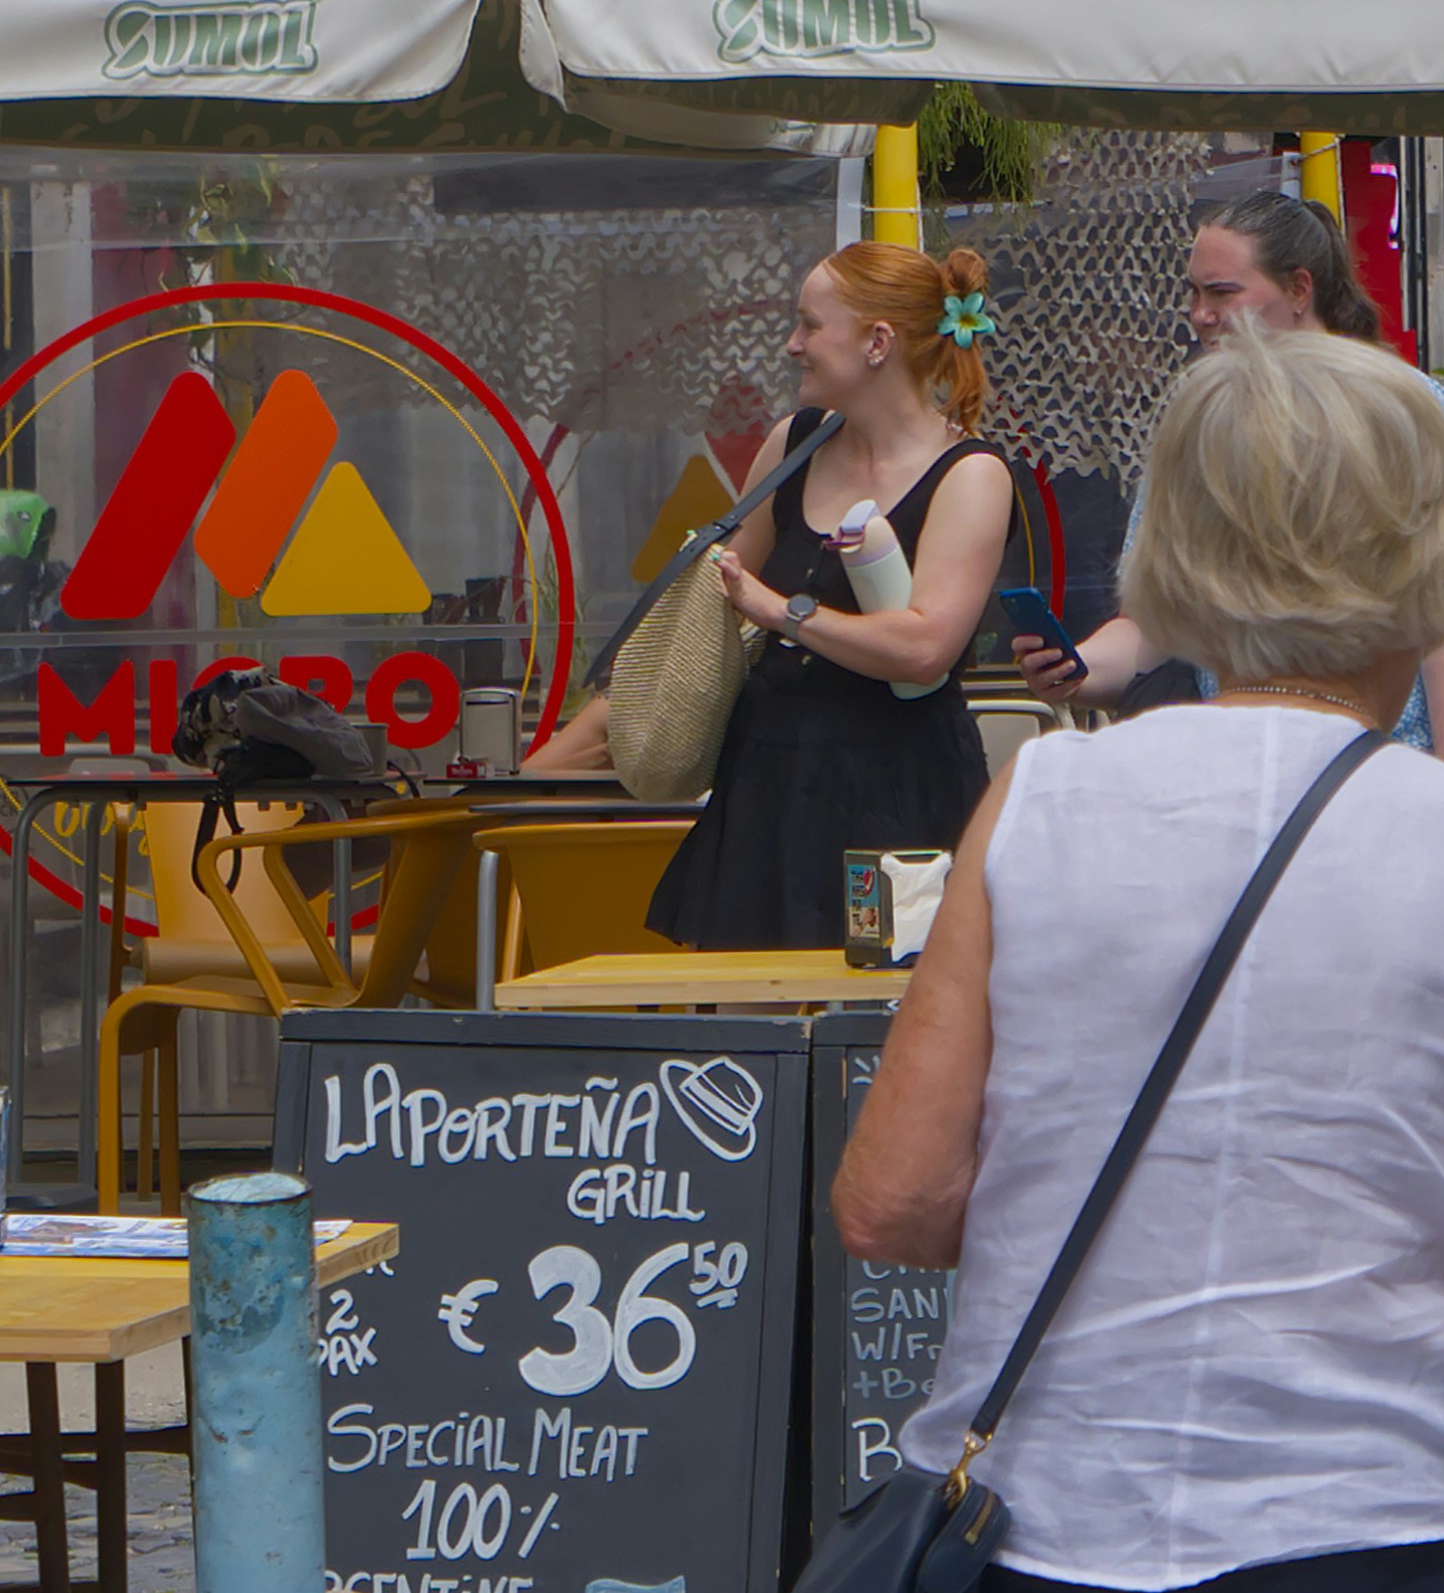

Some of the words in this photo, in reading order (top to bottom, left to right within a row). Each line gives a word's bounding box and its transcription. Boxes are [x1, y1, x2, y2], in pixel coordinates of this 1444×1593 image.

[37, 651, 459, 757] MIRO
[527, 1406, 649, 1483] MEAT
[401, 1479, 561, 1561] 100%
